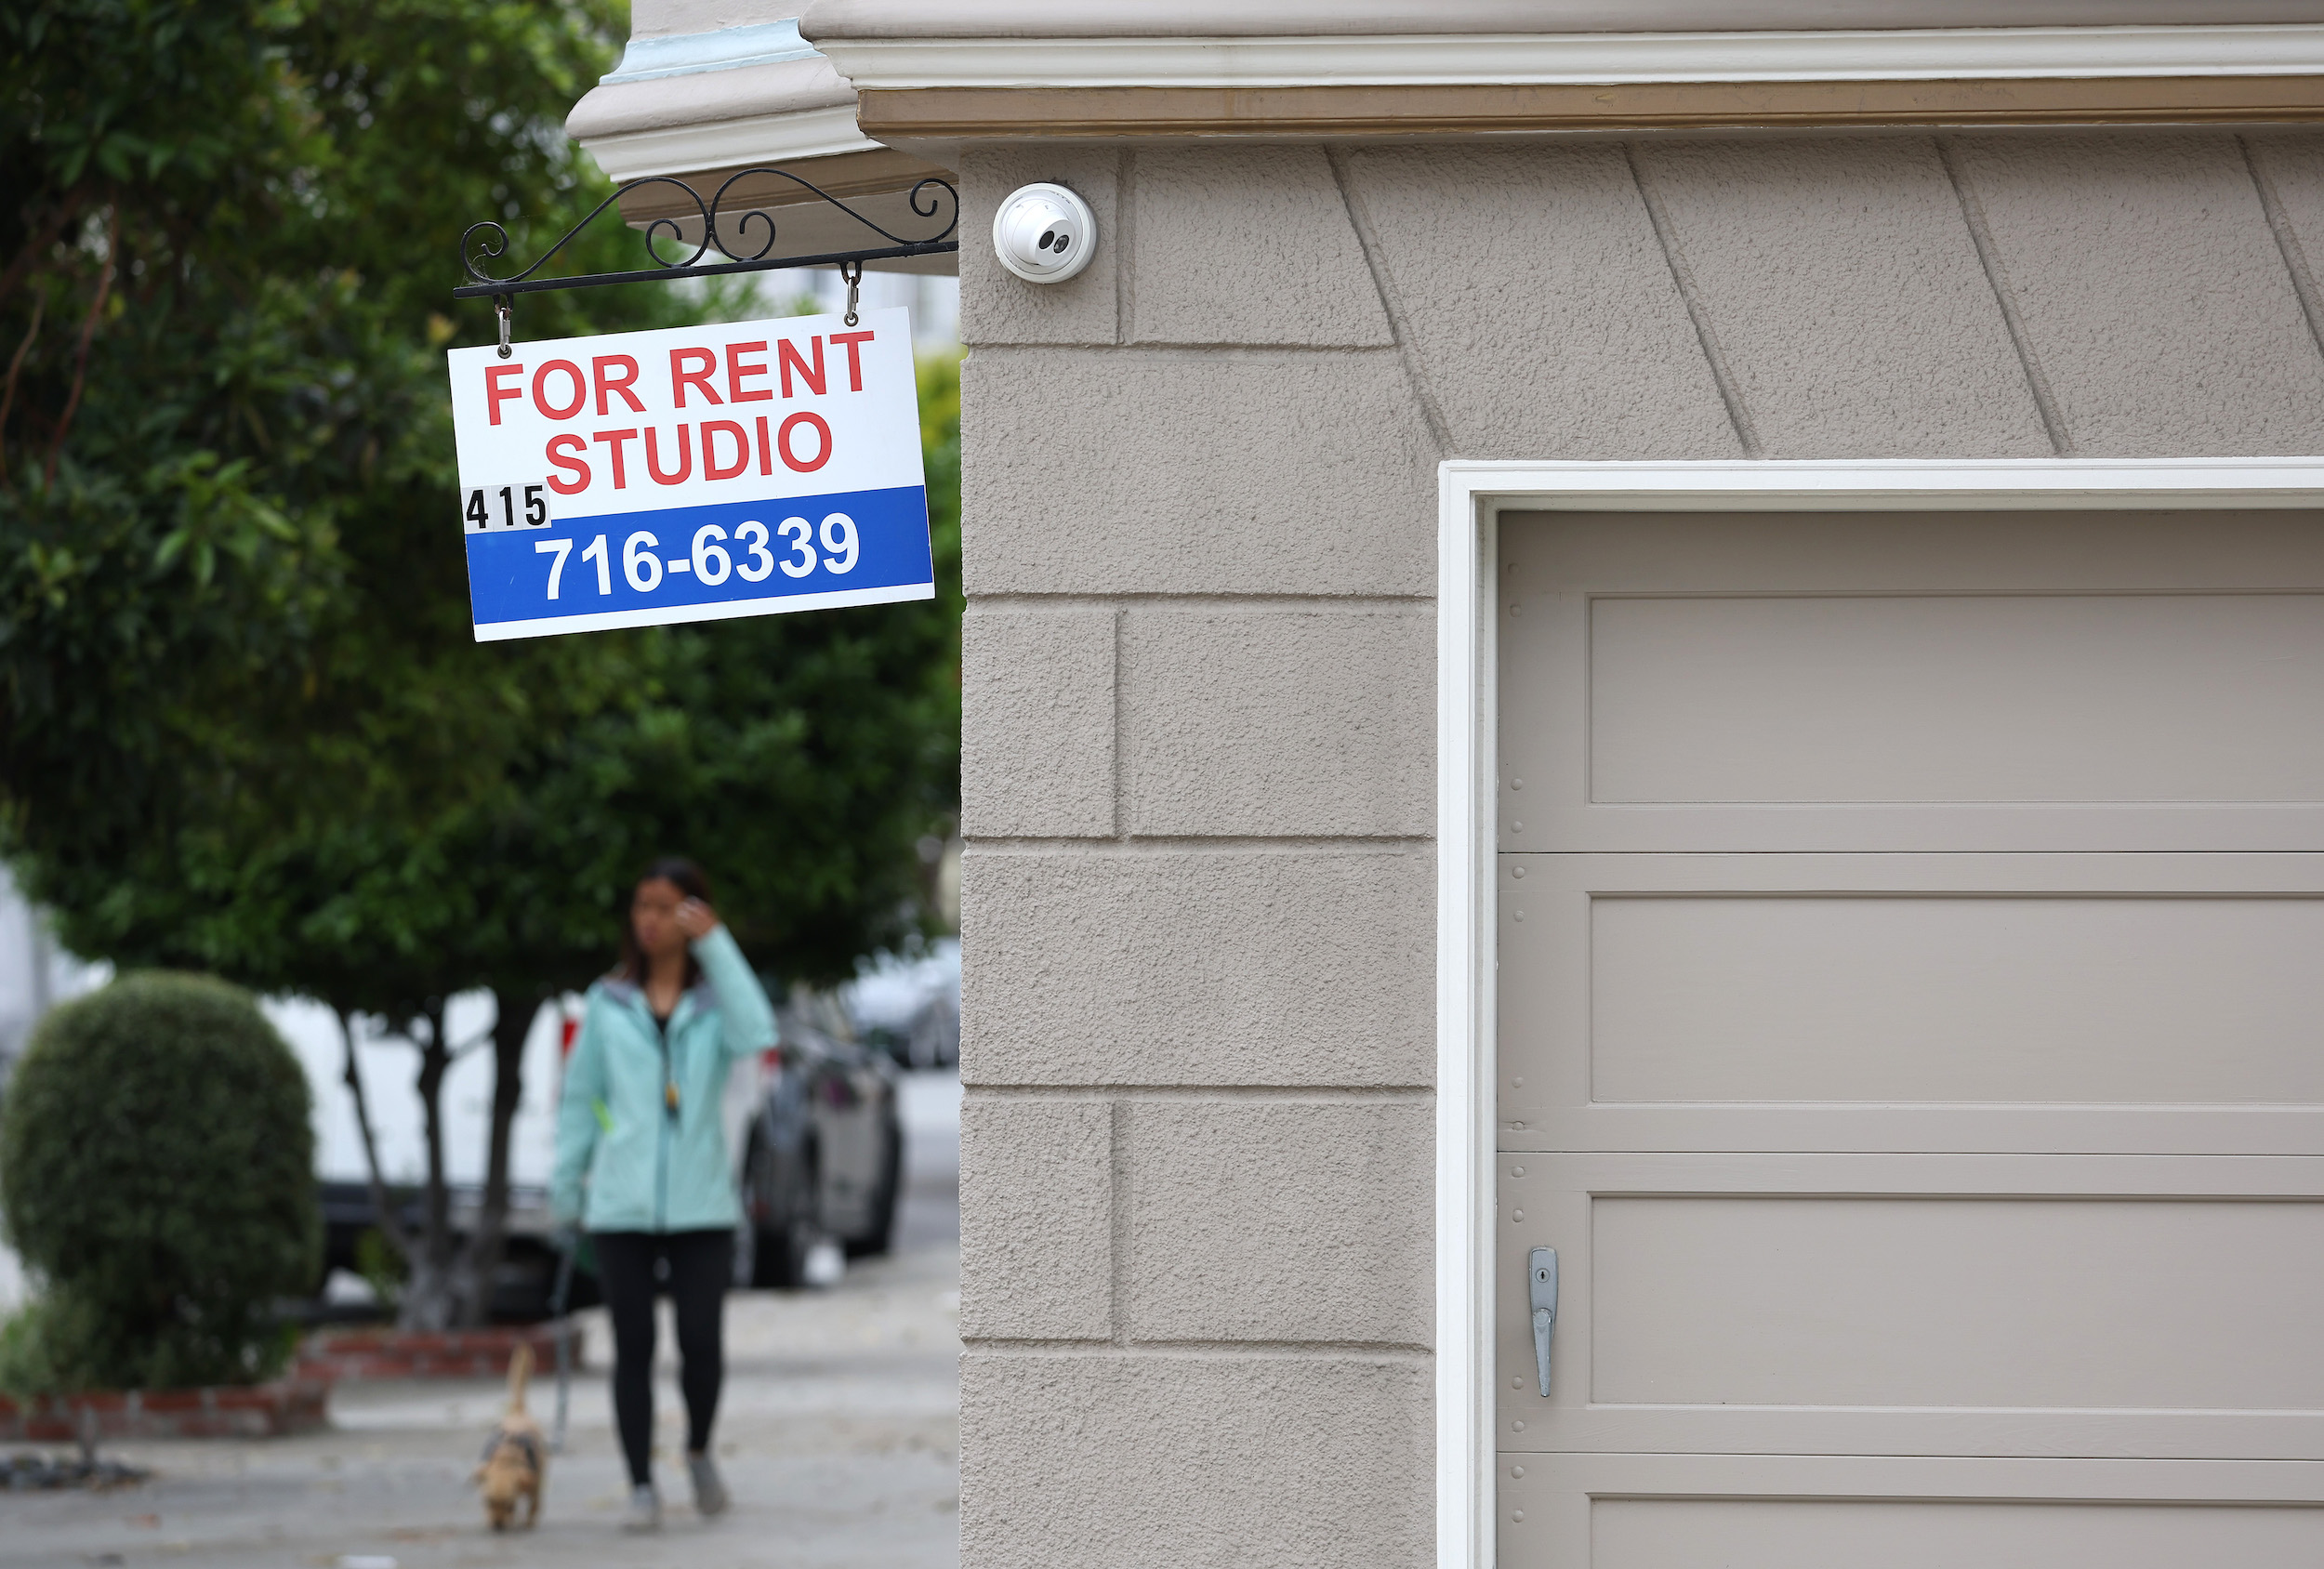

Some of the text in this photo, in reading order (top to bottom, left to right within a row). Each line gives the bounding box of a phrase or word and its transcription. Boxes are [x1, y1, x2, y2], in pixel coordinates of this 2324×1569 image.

[484, 330, 875, 426] FOR RENT
[546, 411, 833, 495] STUDIO
[466, 484, 547, 529] 415
[534, 512, 861, 600] 716-6339
